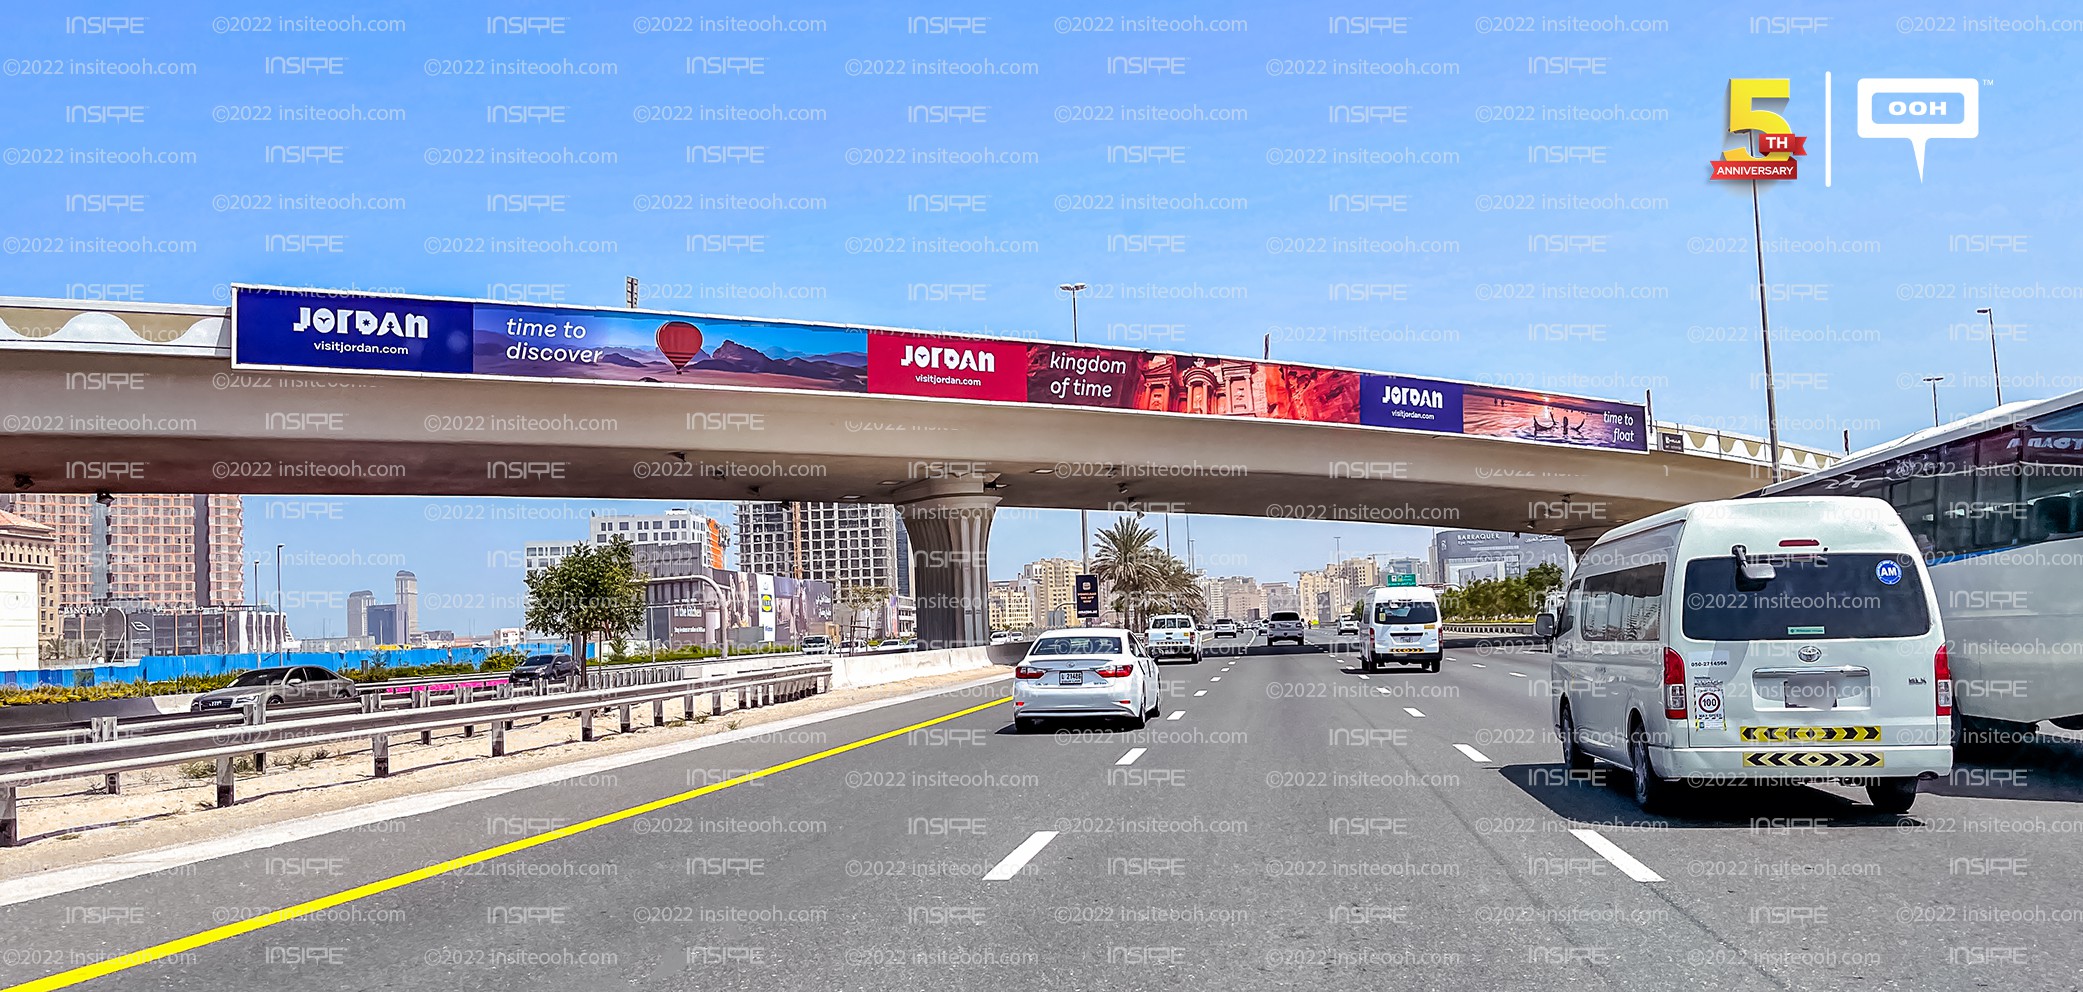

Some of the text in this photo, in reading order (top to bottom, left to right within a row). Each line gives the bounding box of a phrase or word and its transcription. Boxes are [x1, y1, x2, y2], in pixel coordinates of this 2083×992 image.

[506, 317, 587, 340] time to
[313, 340, 409, 355] visitjordan.com
[505, 342, 604, 363] discover
[1049, 351, 1127, 375] kingdom
[915, 374, 982, 386] visitjordan.com
[1050, 378, 1112, 399] of time
[1391, 410, 1435, 421] visitjordan.com
[1603, 411, 1634, 426] time to
[1612, 429, 1635, 443] float
[1880, 566, 1898, 577] AM
[1702, 698, 1717, 707] 100
